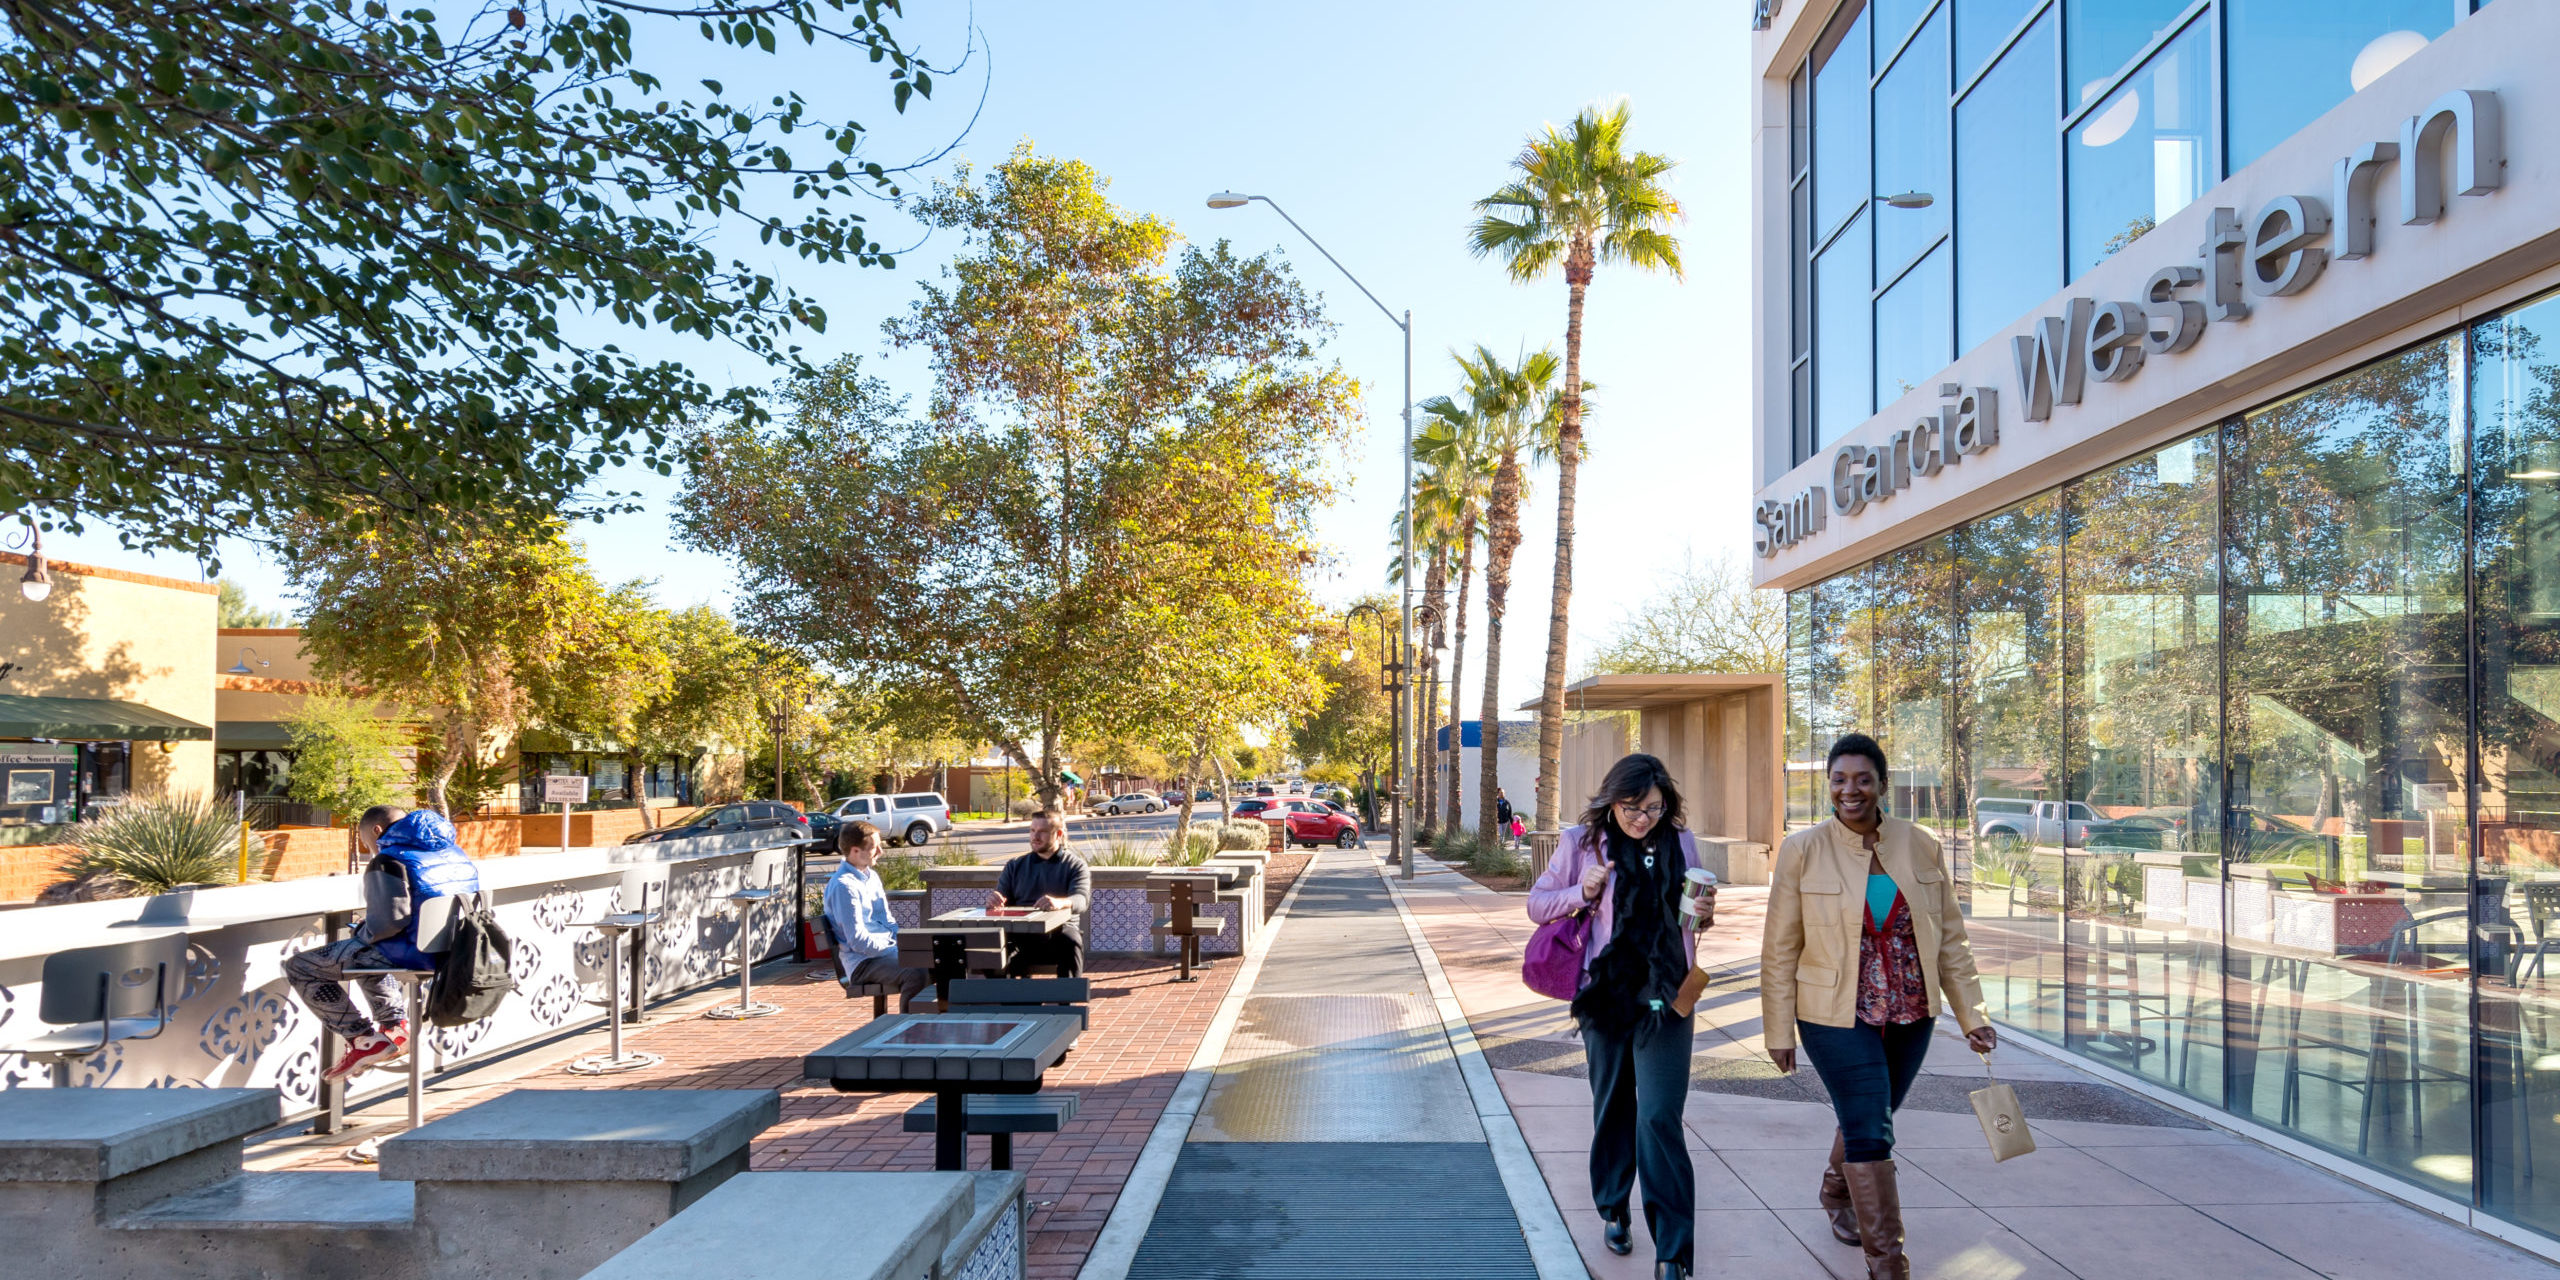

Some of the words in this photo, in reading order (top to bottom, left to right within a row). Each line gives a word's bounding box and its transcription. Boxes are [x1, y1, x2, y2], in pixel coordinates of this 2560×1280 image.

[1754, 486, 1826, 558] Sam
[1831, 383, 1999, 516] Garcia
[2011, 89, 2500, 422] Western
[0, 755, 21, 764] ffee
